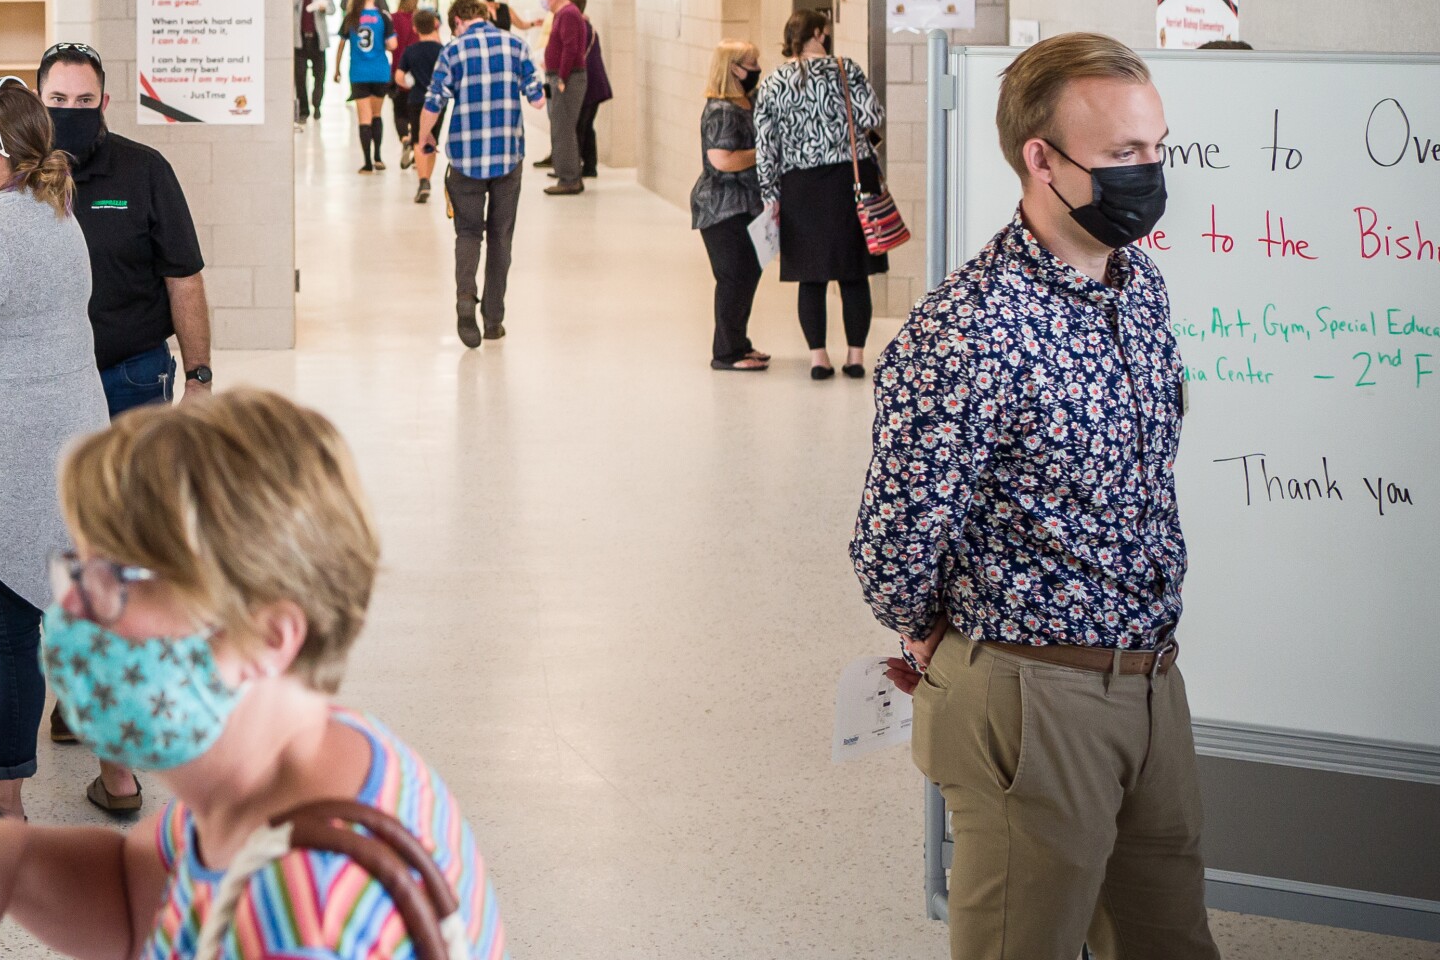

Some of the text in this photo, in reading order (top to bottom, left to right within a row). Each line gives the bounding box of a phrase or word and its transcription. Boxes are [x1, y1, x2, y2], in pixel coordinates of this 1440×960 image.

[167, 28, 180, 36] my
[183, 27, 206, 35] mind
[176, 37, 189, 45] do
[357, 25, 375, 52] 3
[170, 65, 182, 73] do
[184, 66, 198, 75] my
[200, 65, 219, 73] best
[176, 56, 187, 64] be
[190, 57, 203, 66] my
[206, 56, 225, 64] best
[227, 56, 245, 64] and
[151, 75, 189, 83] because
[215, 76, 228, 84] my
[1261, 109, 1302, 171] to
[1202, 204, 1234, 253] to
[1258, 210, 1318, 260] the
[1353, 206, 1440, 262] Bish
[1263, 303, 1310, 343] Gym,
[1315, 306, 1376, 339] Special
[1216, 356, 1274, 384] Center
[1352, 348, 1402, 387] 2nd
[1414, 353, 1433, 389] F
[1213, 453, 1413, 516] Thank you
